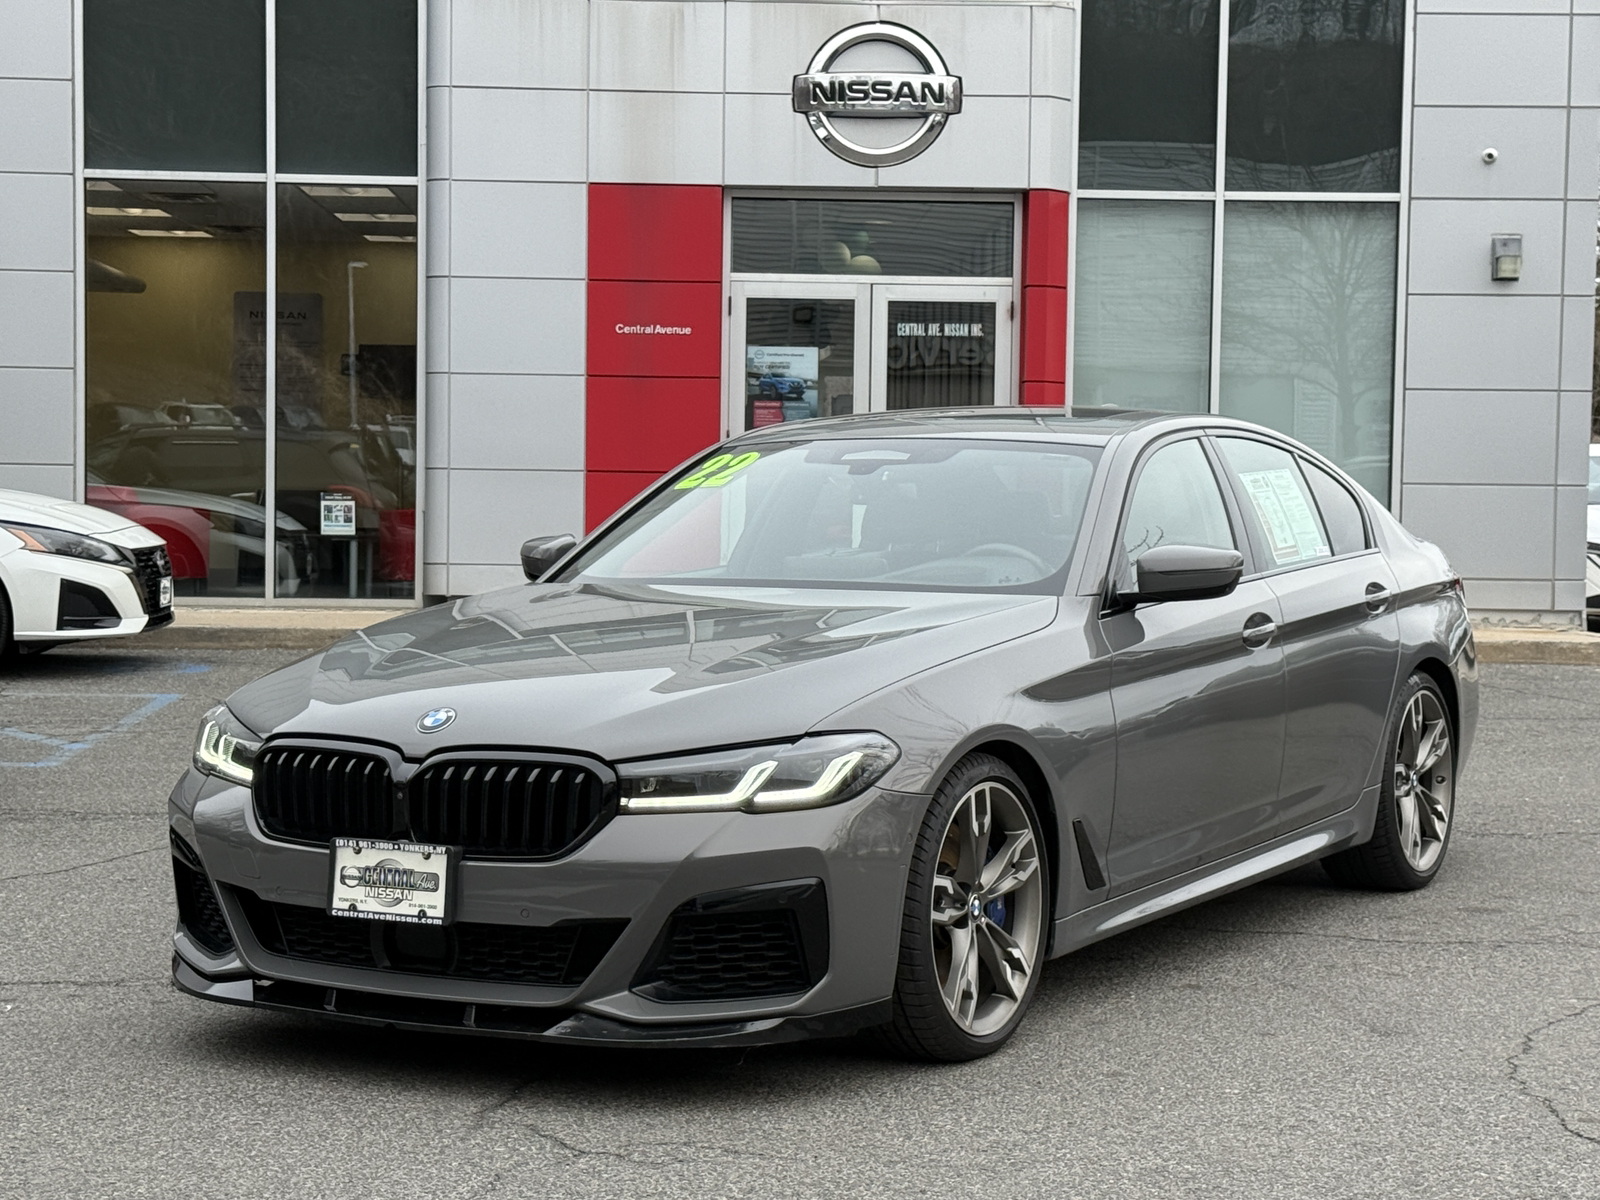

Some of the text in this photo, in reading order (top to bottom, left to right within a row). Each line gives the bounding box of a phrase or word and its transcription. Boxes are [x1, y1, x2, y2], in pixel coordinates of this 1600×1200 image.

[810, 80, 945, 105] NISSAN
[249, 310, 307, 320] NISAN
[615, 323, 692, 335] Central Avenue
[897, 323, 985, 337] CENTRAL AVE. NISSAN INC.
[674, 452, 761, 490] 22
[364, 866, 437, 889] CENTRAL Ave.
[364, 886, 414, 901] NISSAN
[331, 909, 443, 925] CentralAveNissan.com
